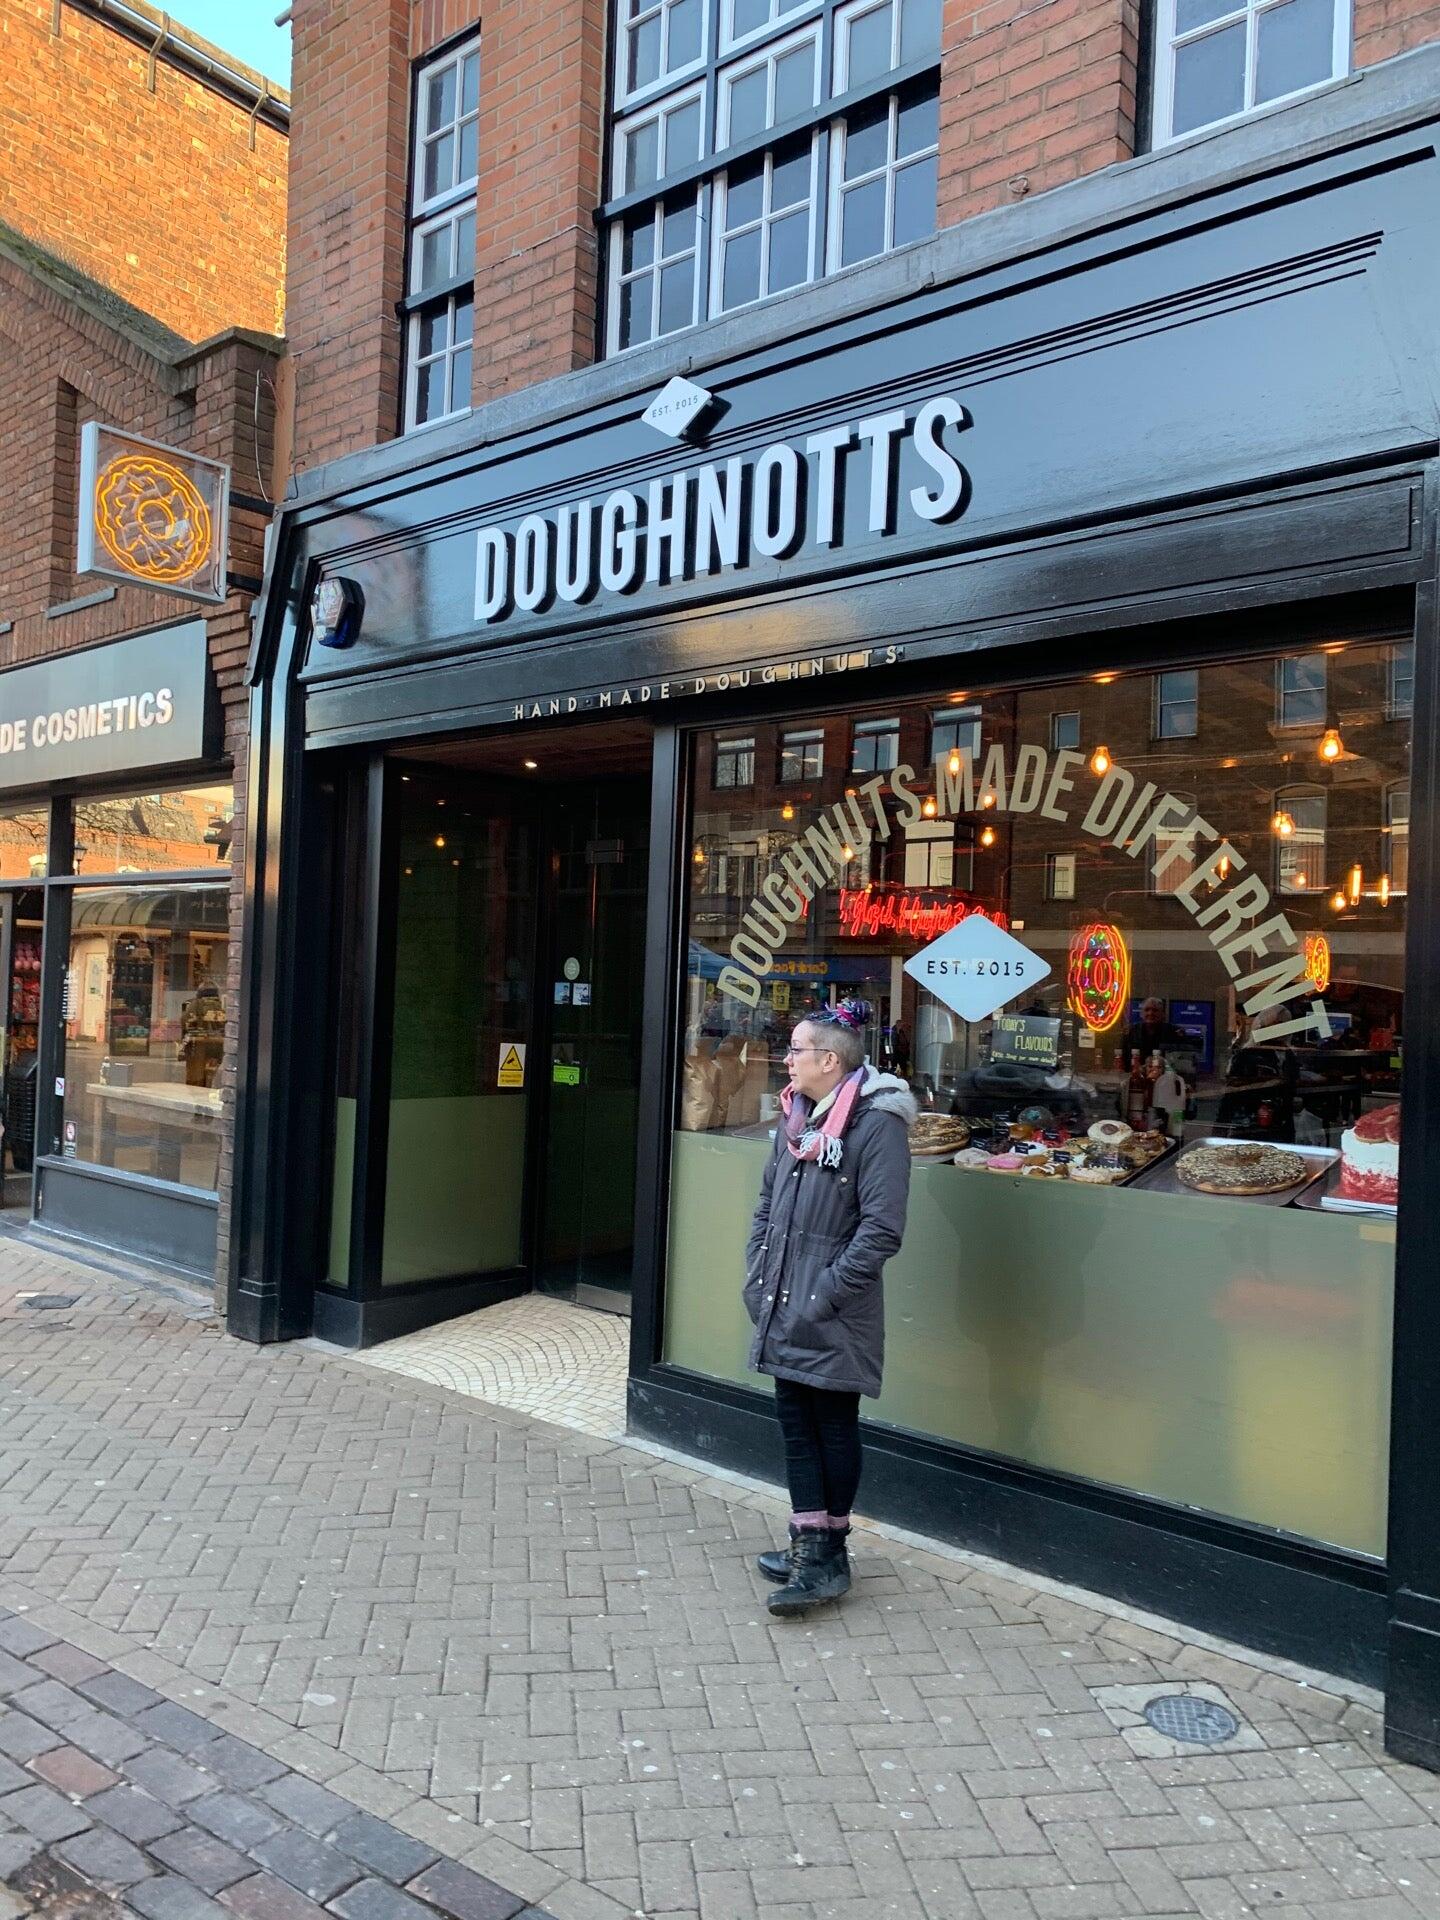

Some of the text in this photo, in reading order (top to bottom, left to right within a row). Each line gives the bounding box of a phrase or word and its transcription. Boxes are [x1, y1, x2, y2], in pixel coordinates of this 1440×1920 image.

[652, 395, 698, 418] EST. 2015
[473, 397, 965, 621] DOUGHNOTTS
[515, 646, 898, 720] HAND MADE DOUGHNUTS
[32, 688, 174, 748] COSMETICS
[716, 744, 1334, 1043] DOUGHNUTS MADE DIFFERENT
[927, 960, 1024, 976] EST. 2015
[1014, 1035, 1053, 1052] FLAVOURS
